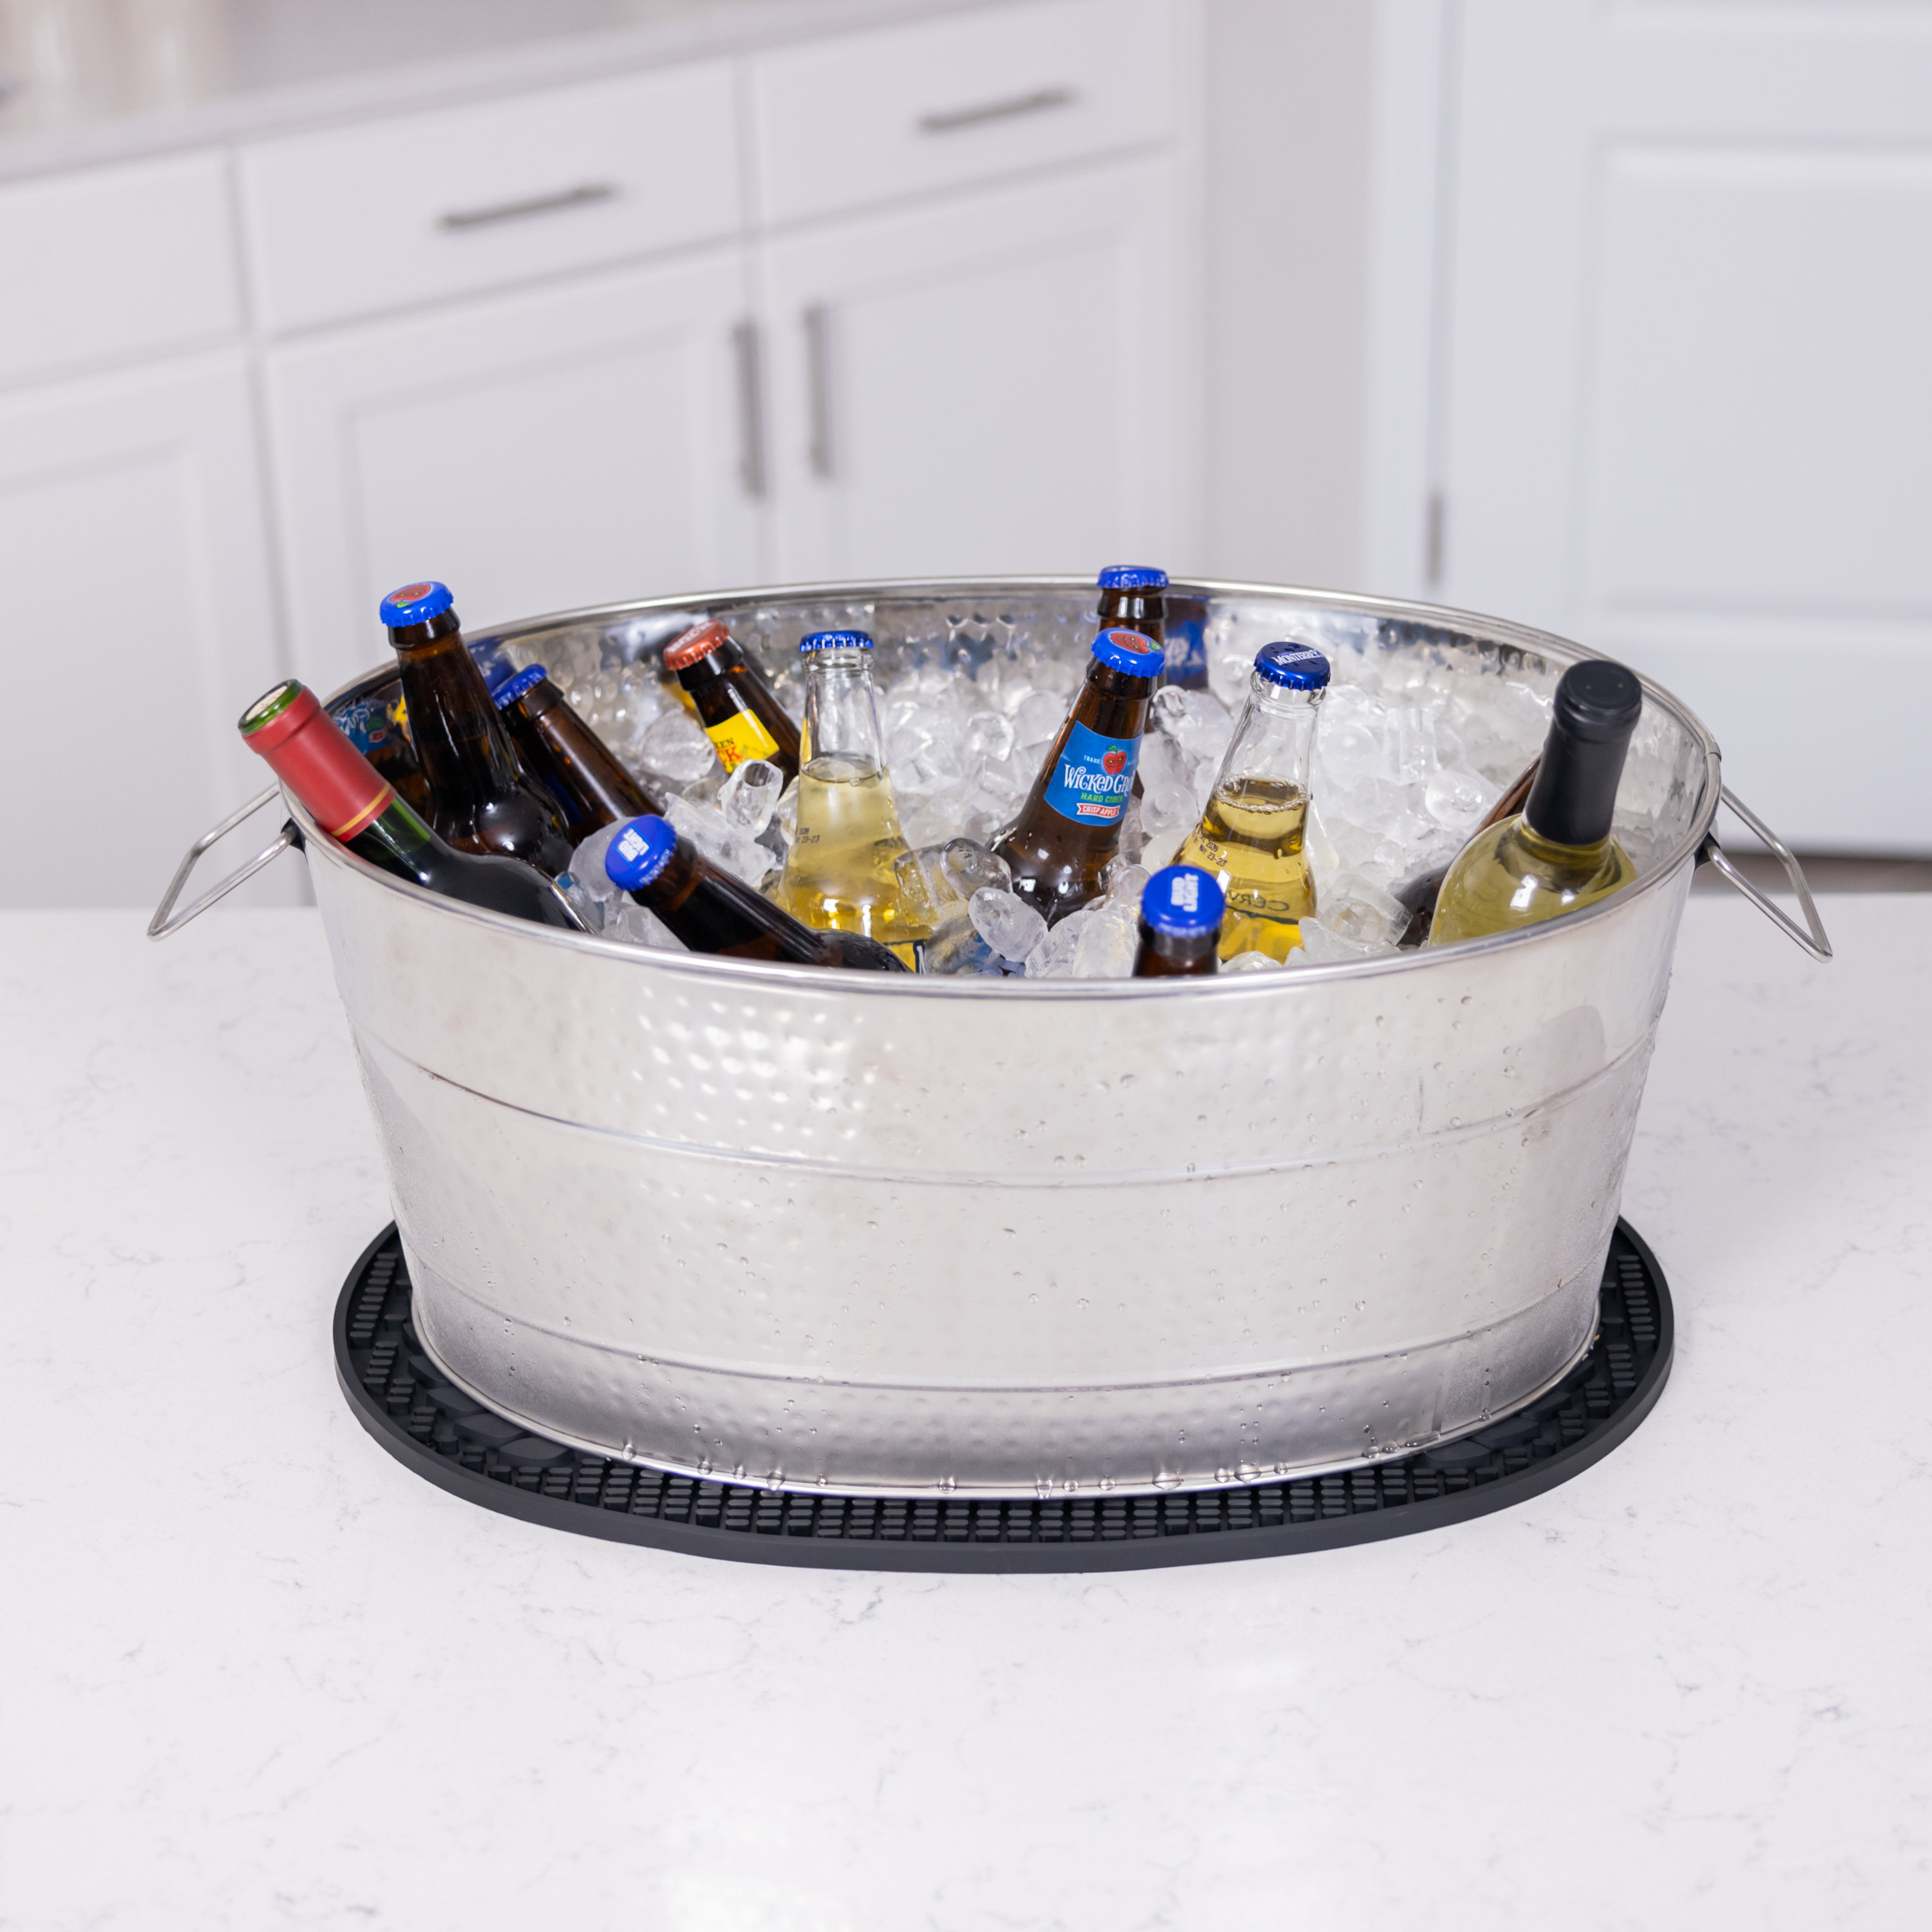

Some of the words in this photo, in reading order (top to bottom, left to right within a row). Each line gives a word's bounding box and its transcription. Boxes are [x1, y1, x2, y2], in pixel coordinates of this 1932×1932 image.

[1271, 649, 1320, 665] MONTERREY
[1084, 755, 1100, 764] TRADE
[1081, 791, 1104, 803] HARD
[1104, 794, 1124, 804] CIDER
[1083, 805, 1101, 814] CRISP
[1099, 807, 1117, 817] APPLE
[623, 828, 650, 856] LIGHT
[619, 840, 639, 862] BUD
[1207, 851, 1228, 867] 23-23
[1170, 876, 1186, 906] BUD
[1183, 873, 1199, 913] LIGHT
